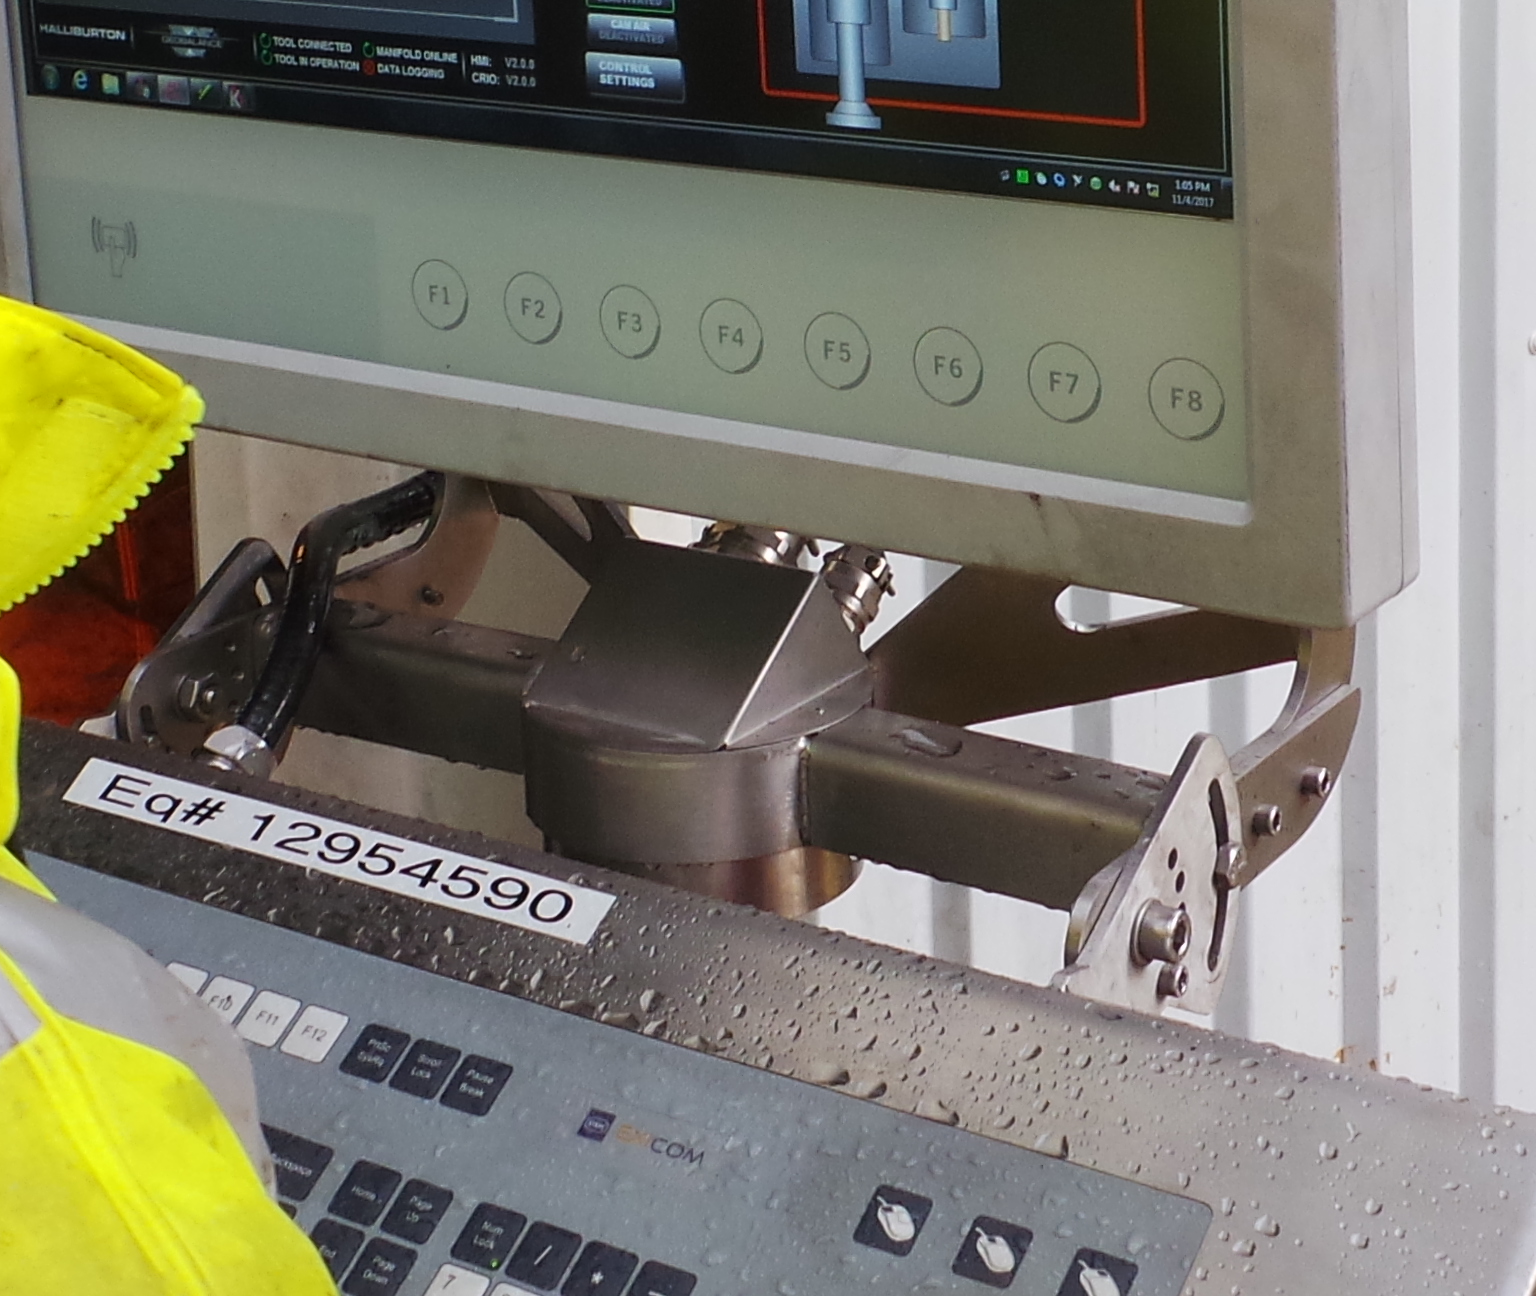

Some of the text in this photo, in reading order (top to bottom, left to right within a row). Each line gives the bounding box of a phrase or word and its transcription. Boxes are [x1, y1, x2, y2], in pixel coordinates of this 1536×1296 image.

[39, 23, 126, 41] HALLIBURTON
[633, 21, 650, 31] AIR
[273, 36, 352, 54] TOOL CONNECTED
[598, 30, 665, 45] DEACTIVATED
[274, 53, 360, 72] TOOL IN OPERATION
[376, 45, 458, 64] MANIFOLD ONLINE
[470, 54, 536, 70] HMI: V2.0.0
[377, 63, 445, 80] DATA LOGGING
[599, 61, 653, 75] CONTROL
[471, 72, 537, 88] CRIO: V2.0.0
[599, 74, 655, 89] SETTINGS
[1195, 181, 1210, 192] PM
[1172, 194, 1214, 208] 11/4/2017
[428, 284, 451, 306] F1
[520, 298, 545, 319] F2
[616, 311, 643, 333] F3
[718, 325, 744, 347] F4
[822, 340, 851, 363] F5
[933, 355, 964, 379] F6
[1048, 371, 1080, 396] F7
[1170, 387, 1204, 412] F8
[98, 774, 573, 924] Eq# 12954590
[207, 995, 234, 1011] F10
[256, 1010, 280, 1026] F11
[301, 1025, 328, 1042] F12
[417, 1054, 443, 1067] Scroll
[410, 1066, 432, 1079] Lock
[466, 1069, 495, 1084] Pause
[459, 1082, 485, 1099] Break
[271, 1152, 313, 1178] ackspace
[351, 1185, 378, 1201] Home
[409, 1195, 433, 1212] Page
[406, 1211, 420, 1223] Up
[481, 1220, 505, 1235] Num
[473, 1236, 495, 1250] Lock
[319, 1244, 337, 1260] End
[372, 1255, 396, 1272] Page
[362, 1269, 389, 1286] Down
[441, 1274, 457, 1290] 7
